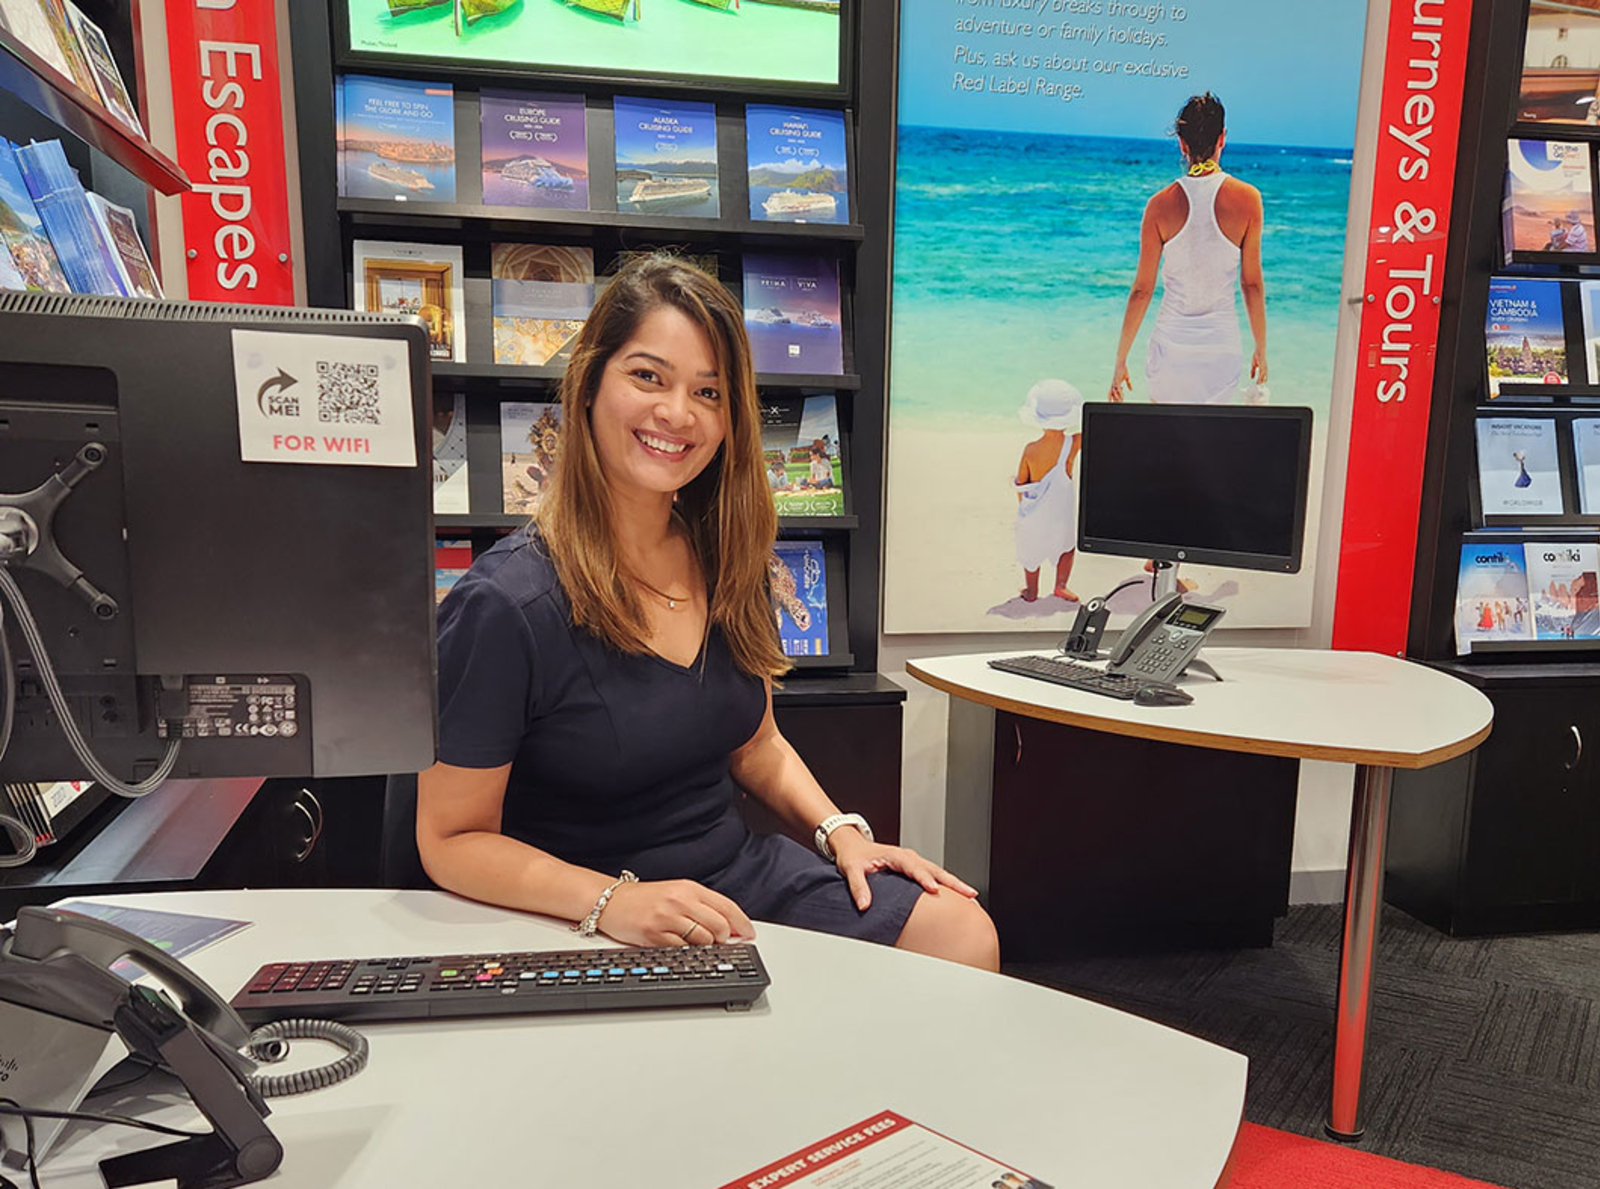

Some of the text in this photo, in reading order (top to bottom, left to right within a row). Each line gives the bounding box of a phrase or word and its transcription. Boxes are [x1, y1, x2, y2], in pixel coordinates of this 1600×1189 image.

[1051, 0, 1103, 15] breaks
[1108, 1, 1166, 24] through
[1170, 6, 1188, 20] to
[954, 15, 1168, 50] adventure or family holidays.
[954, 45, 1189, 78] Plus, ask us about our exclusive
[953, 72, 1085, 102] Red Label Range.
[403, 109, 420, 117] AND
[420, 111, 434, 119] GO
[519, 108, 546, 116] EUROPE
[504, 114, 561, 125] CRUISING GUIDE
[653, 117, 679, 125] ALASKA
[639, 122, 693, 134] CRUISING GUIDE
[769, 128, 822, 139] CRUISING GUIDE
[191, 40, 262, 290] Escapes
[1376, 0, 1445, 404] urneys & Tours
[1489, 298, 1538, 308] VIETNAM &
[1490, 307, 1539, 317] CAMBODIA
[268, 396, 299, 404] SCAN
[269, 404, 300, 417] ME!
[273, 434, 370, 453] FOR WIFI
[747, 1158, 808, 1189] EXPERT
[807, 1132, 867, 1163] SERVICE
[863, 1117, 896, 1137] FEES
